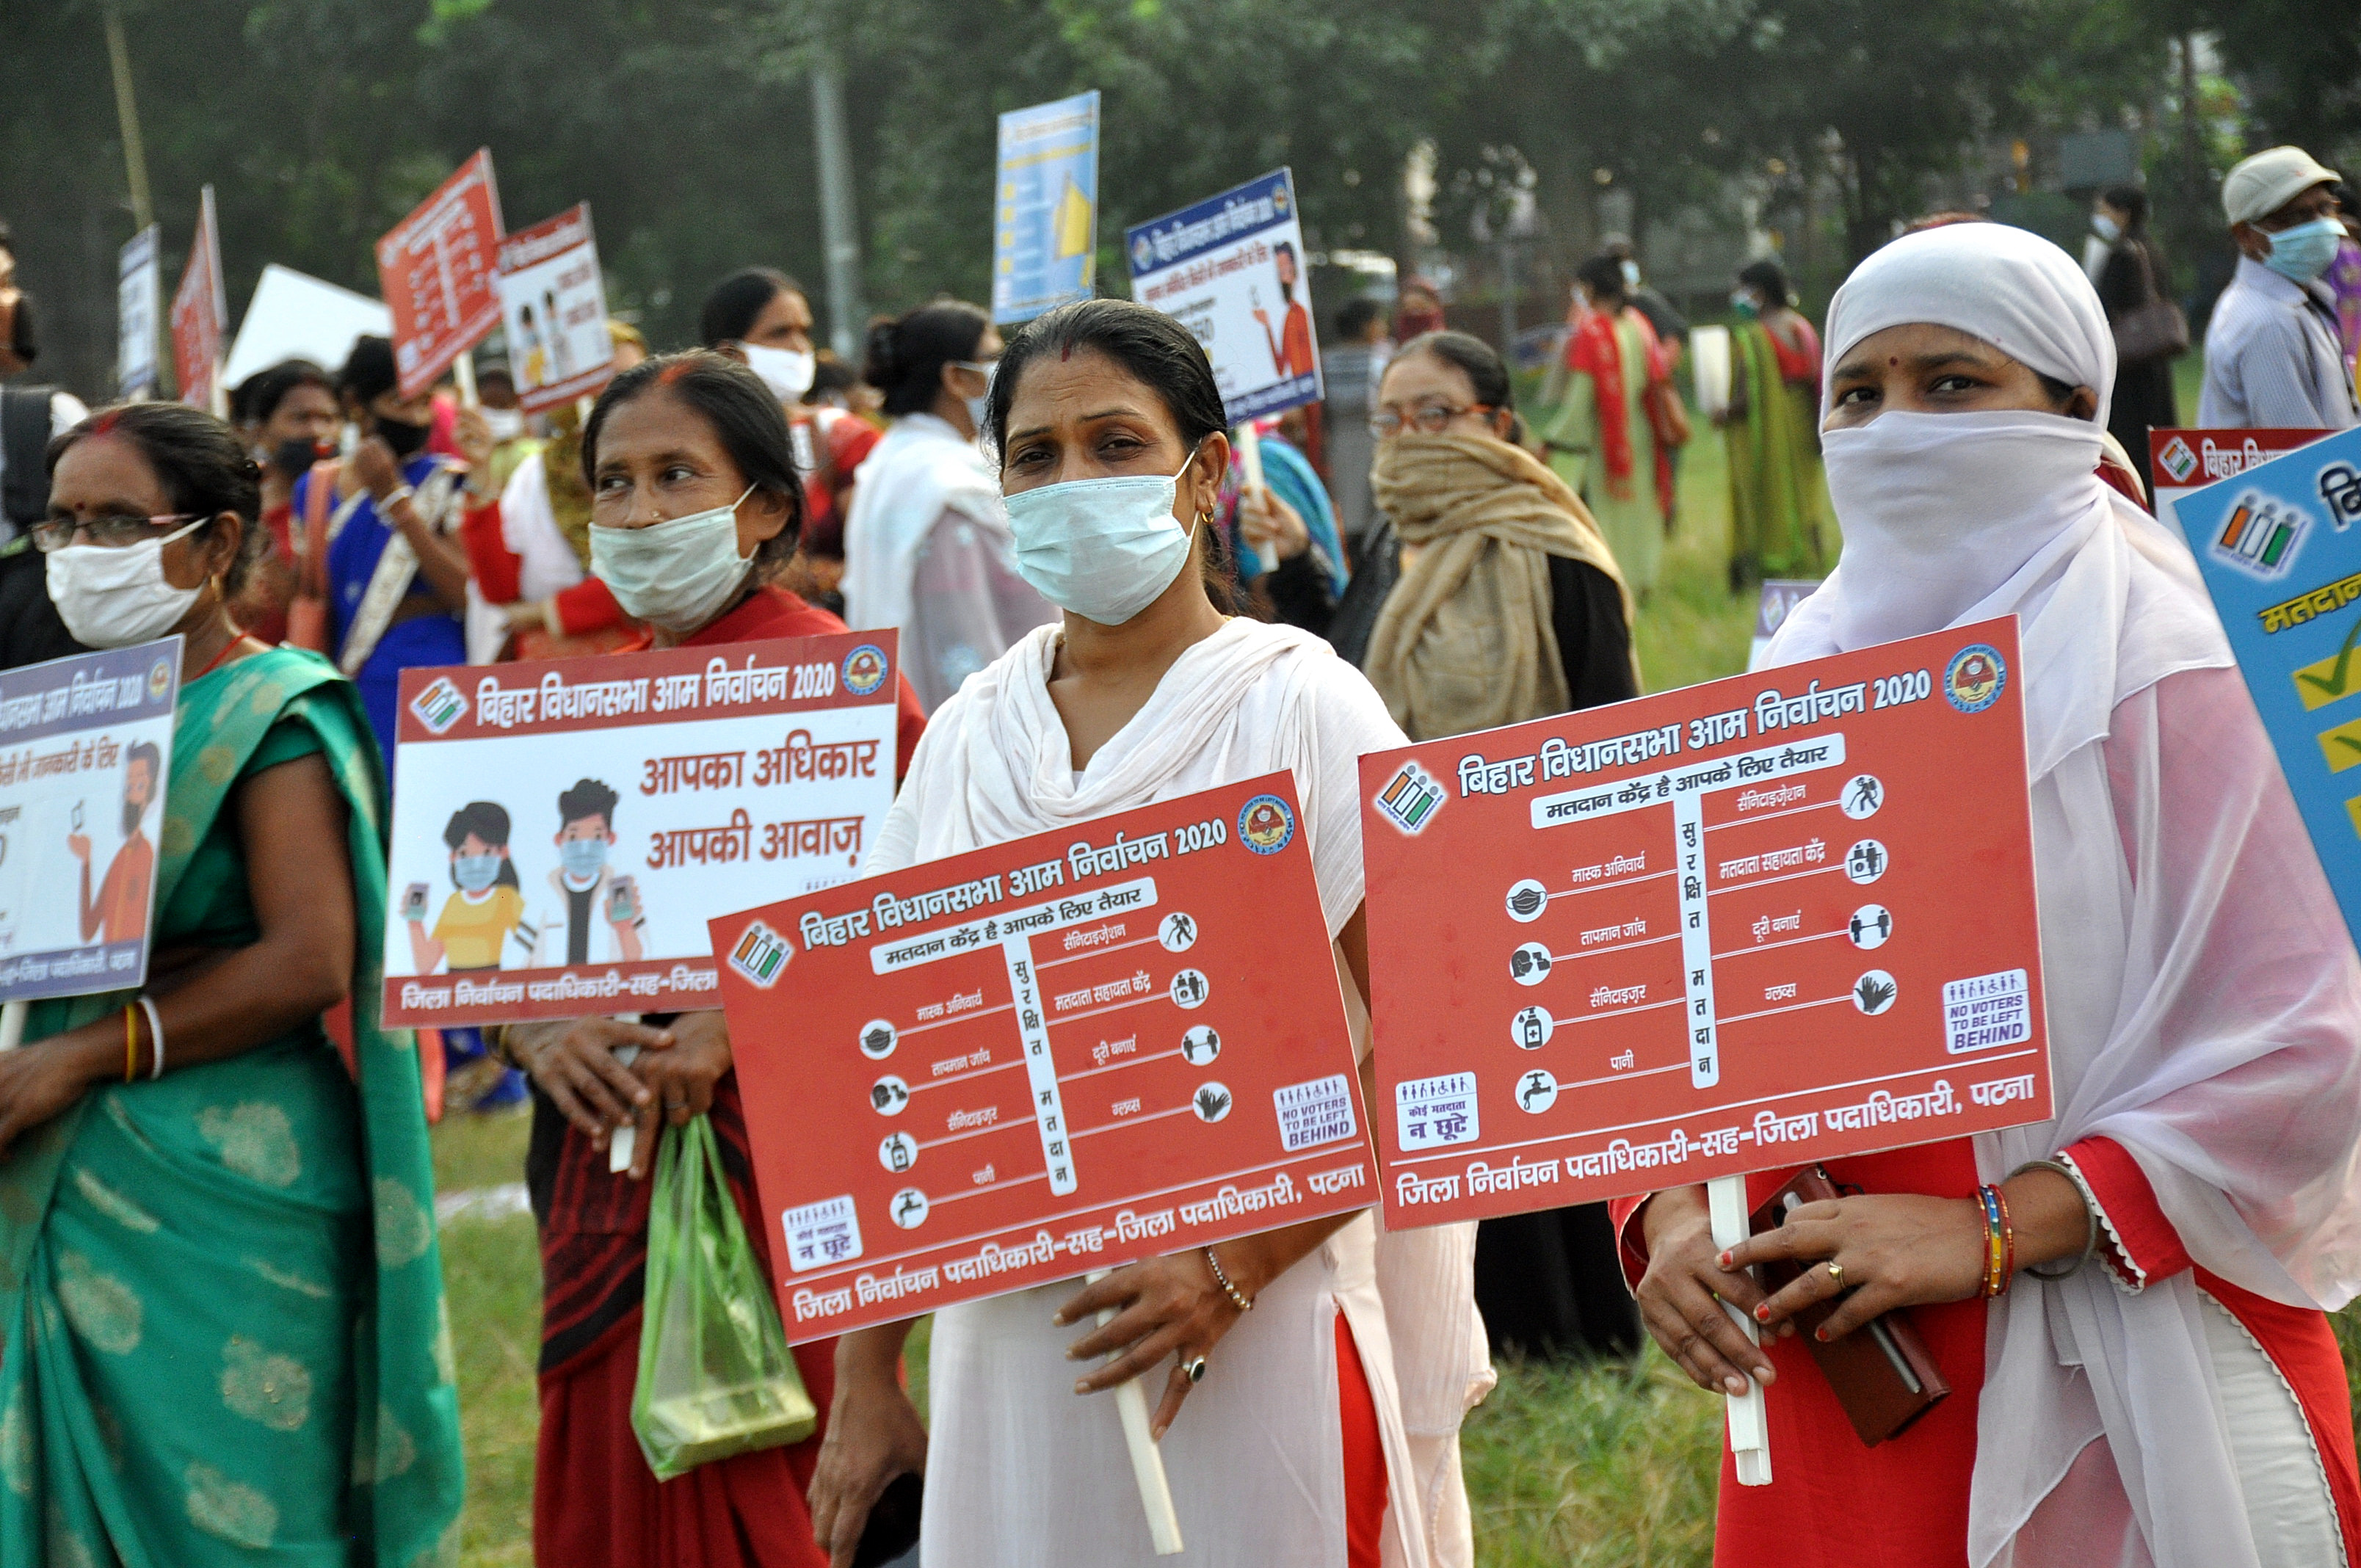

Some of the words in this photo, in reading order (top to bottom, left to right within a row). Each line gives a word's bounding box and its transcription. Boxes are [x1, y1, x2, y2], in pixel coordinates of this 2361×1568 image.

[475, 674, 536, 728] बिहार
[540, 669, 647, 723] विधानसभा
[653, 673, 698, 714] आम
[704, 653, 787, 708] निर्वाचन
[791, 661, 836, 700] 2020
[1458, 755, 1535, 798] बिहार
[1540, 724, 1681, 780] विधानसभा
[1687, 708, 1747, 749] आम
[1755, 679, 1865, 735] निर्वाचन
[1872, 668, 1932, 709] 2020
[639, 749, 744, 796] आपका
[753, 729, 879, 788] अधिकार
[1546, 796, 1611, 818] मतदान
[1617, 783, 1650, 805] केंद्र
[1656, 775, 1669, 797] है
[1675, 762, 1732, 792] आपके
[1738, 752, 1773, 776] लिए
[1780, 744, 1828, 769] तैयार
[646, 808, 753, 871] आपकी
[761, 815, 864, 867] आवाज़
[1573, 865, 1602, 883] मास्क
[1605, 850, 1645, 877] अनिवार्य
[1719, 857, 1760, 879] मतदाता
[1761, 846, 1802, 871] सहायता
[799, 912, 871, 951] बिहार
[872, 875, 1002, 932] विधानसभा
[1009, 858, 1065, 900] आम
[1067, 832, 1169, 881] निर्वाचन
[1175, 818, 1227, 854] 2020
[885, 938, 946, 965] मतदान
[950, 927, 979, 950] केंद्र
[985, 922, 998, 940] है
[1003, 906, 1055, 938] आपके
[1059, 900, 1093, 923] लिए
[1099, 888, 1141, 911] तैयार
[1580, 923, 1621, 945] तापमान
[1622, 916, 1646, 937] जांच
[401, 979, 450, 1010] जिला
[454, 972, 524, 1008] निर्वाचन
[1055, 990, 1092, 1012] मतदाता
[1093, 980, 1131, 1004] सहायता
[1765, 983, 1796, 1001] ग्लव्स
[917, 1003, 943, 1020] मास्क
[1950, 1006, 1968, 1018] NO
[1972, 995, 2023, 1016] VOTERS
[1951, 1020, 1968, 1031] TO
[1972, 1016, 1988, 1027] BE
[1990, 1009, 2023, 1024] LEFT
[1954, 1023, 2023, 1050] BEHIND
[932, 1058, 968, 1076] तापमान
[1611, 1050, 1633, 1070] पानी
[1283, 1110, 1298, 1120] NO
[1301, 1097, 1346, 1117] VOTERS
[1284, 1121, 1299, 1132] TO
[1302, 1117, 1317, 1128] BE
[1319, 1110, 1346, 1125] LEFT
[1288, 1121, 1349, 1147] BEHIND
[1396, 1171, 1459, 1208] जिला
[1467, 1155, 1559, 1197] निर्वाचन
[1565, 1111, 1818, 1179] पदाधिकारी-सह-जिला
[1824, 1079, 1962, 1133] पदाधिकारी,
[1970, 1073, 2034, 1107] पटना
[1408, 1123, 1426, 1141] न
[973, 1164, 995, 1185] पानी
[793, 1288, 852, 1323] जिला
[855, 1267, 939, 1307] निर्वाचन
[944, 1208, 1175, 1285] पदाधिकारी-सह-जिला
[1180, 1174, 1302, 1225] पदाधिकारी,
[1308, 1164, 1366, 1197] पटना
